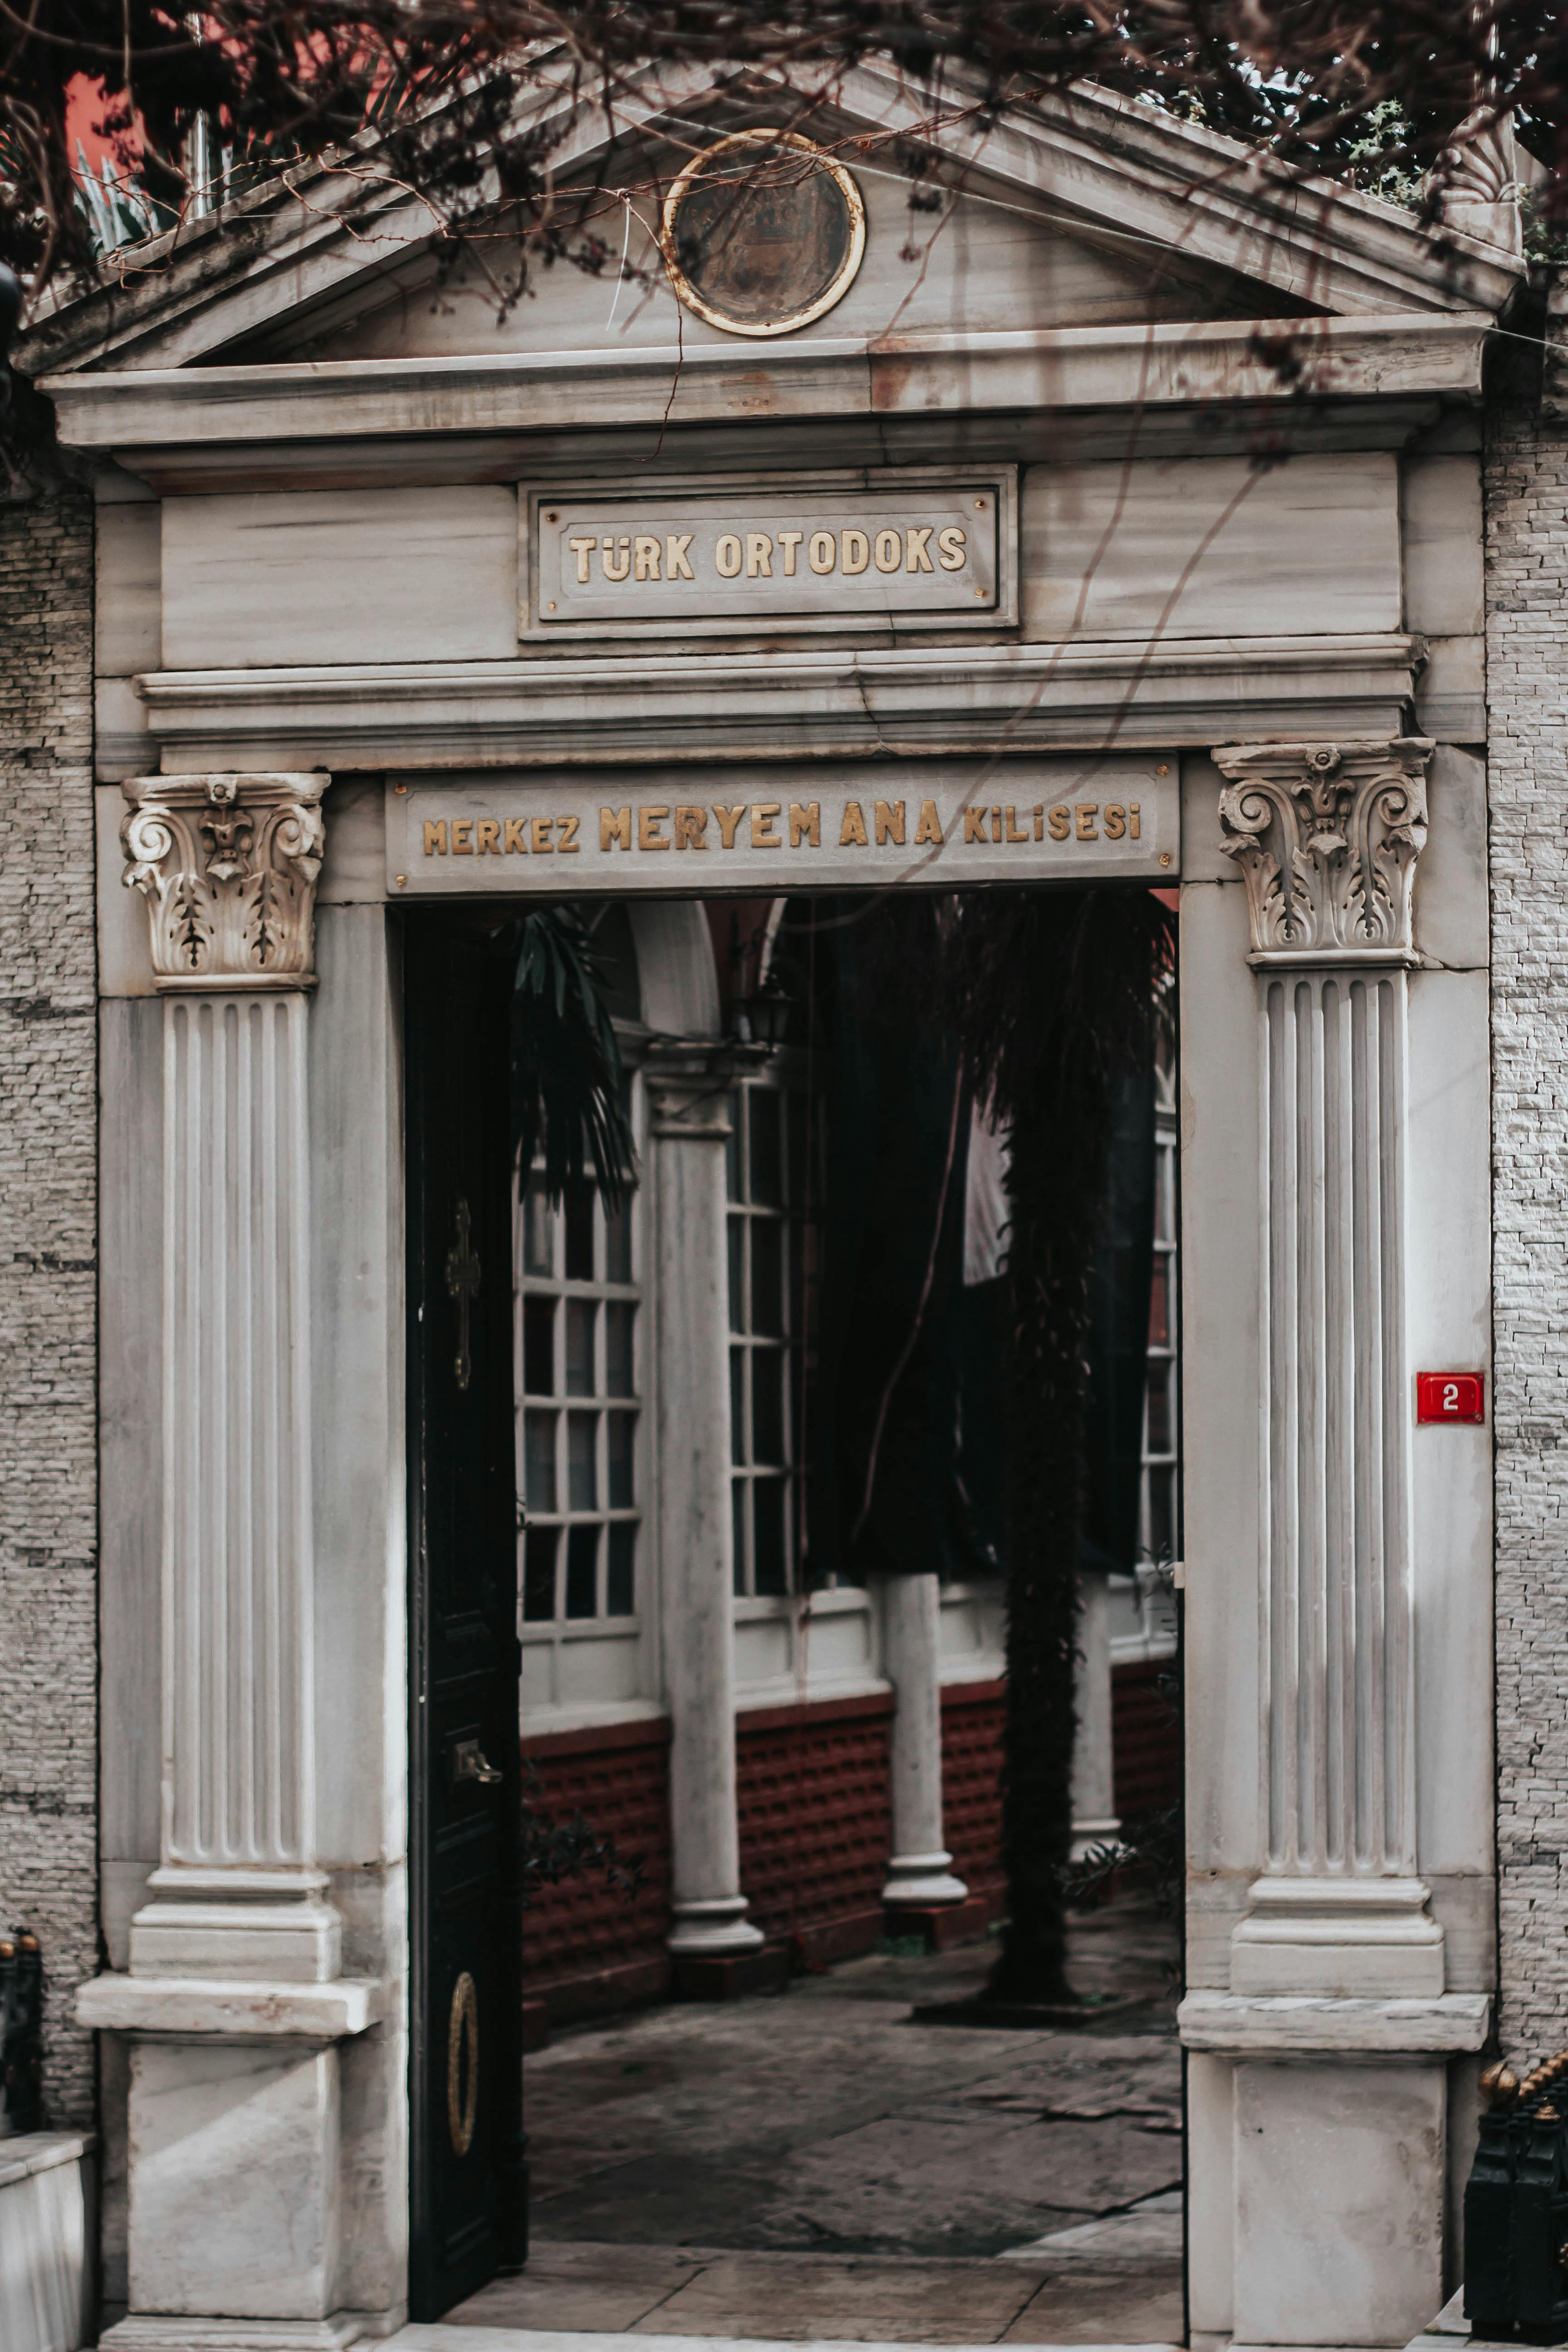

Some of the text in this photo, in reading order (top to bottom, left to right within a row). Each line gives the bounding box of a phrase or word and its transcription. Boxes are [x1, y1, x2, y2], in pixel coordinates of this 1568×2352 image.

[569, 527, 966, 583] TÜRK ORTODOKS
[423, 818, 580, 855] MERKEZ
[600, 802, 820, 851] MERYEM
[838, 800, 945, 846] ANA
[1443, 1383, 1458, 1411] 2
